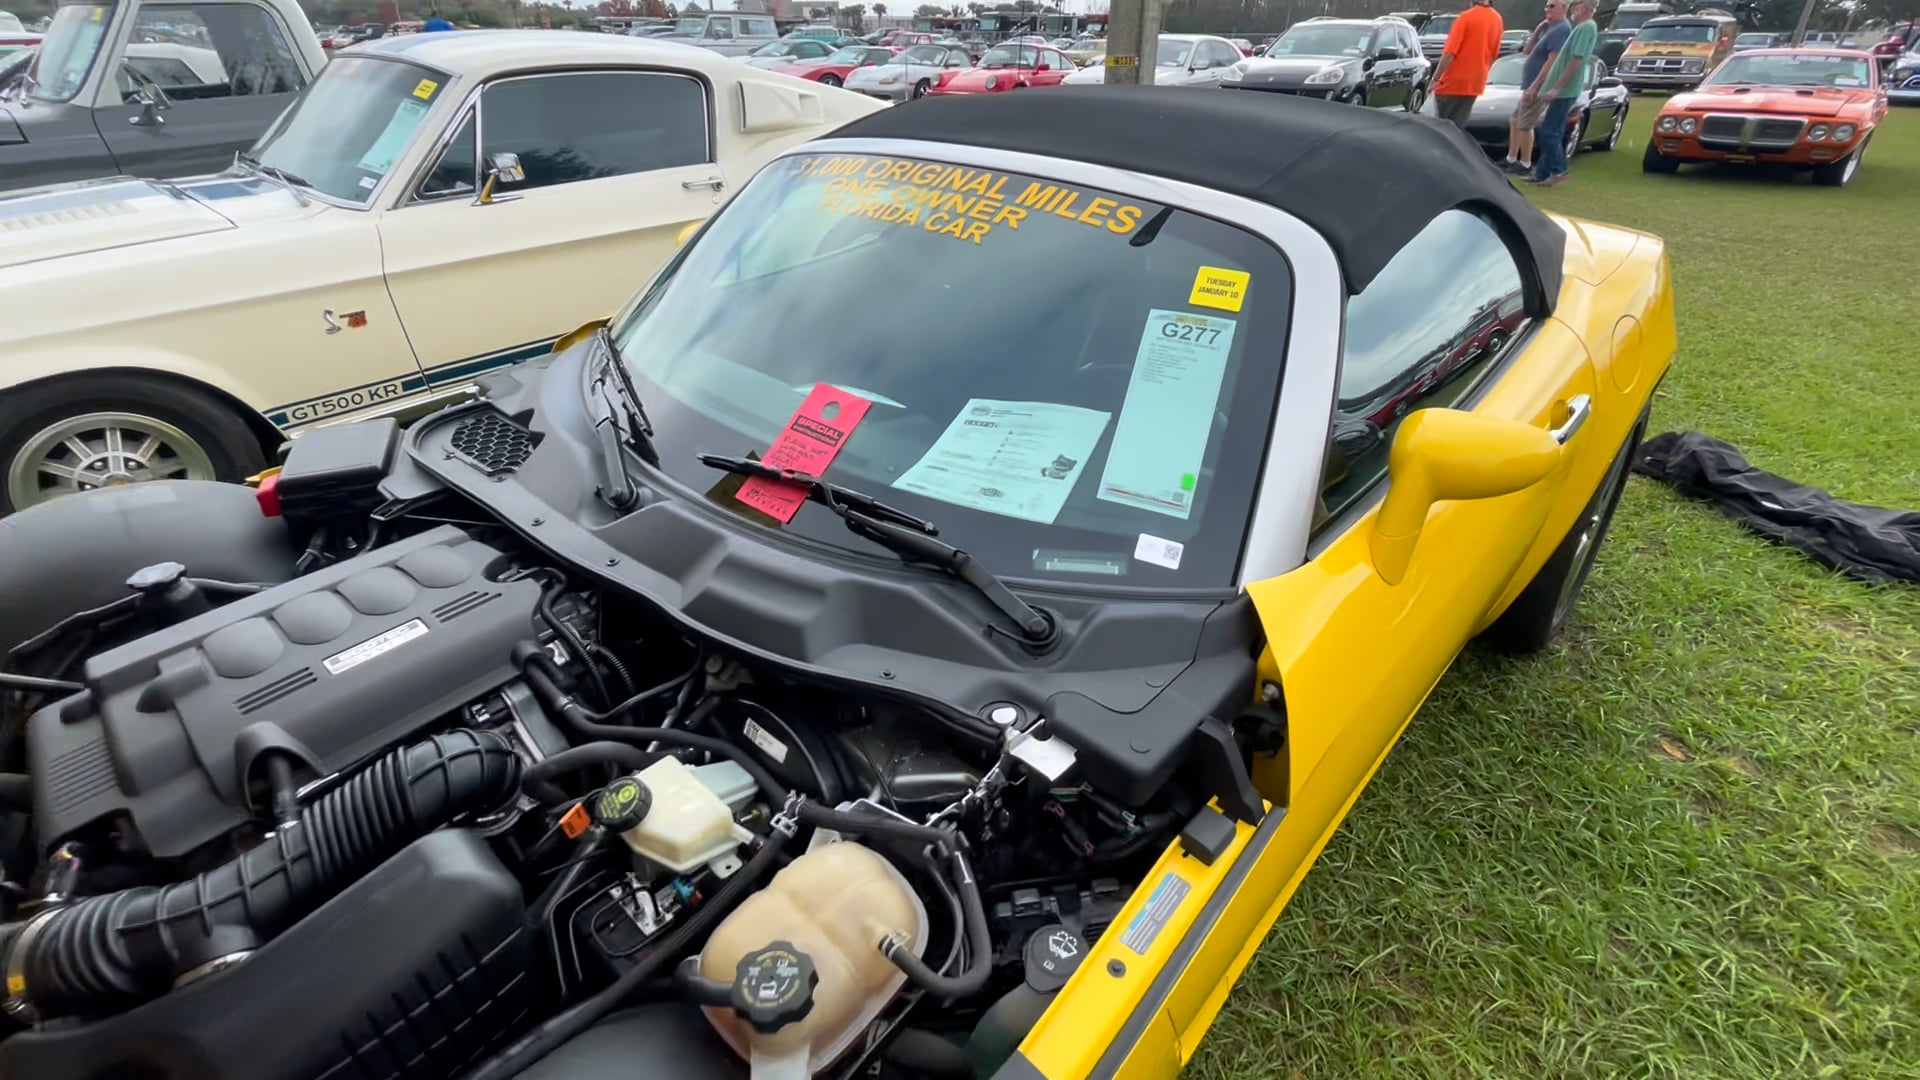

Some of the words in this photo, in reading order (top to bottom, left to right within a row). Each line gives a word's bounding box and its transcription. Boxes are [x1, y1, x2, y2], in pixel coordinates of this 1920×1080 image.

[823, 178, 890, 197] ONE
[892, 185, 1028, 229] OWNER
[865, 159, 1009, 200] ORIGINAL
[1015, 181, 1143, 235] MILES
[816, 198, 922, 226] FLORIDA
[924, 212, 991, 244] CAR
[1198, 286, 1228, 297] JANUARY
[1206, 277, 1237, 287] TUESDAY
[1162, 322, 1221, 344] G277
[292, 393, 364, 420] GT500
[368, 383, 399, 401] KR
[797, 417, 841, 439] SPECIAL
